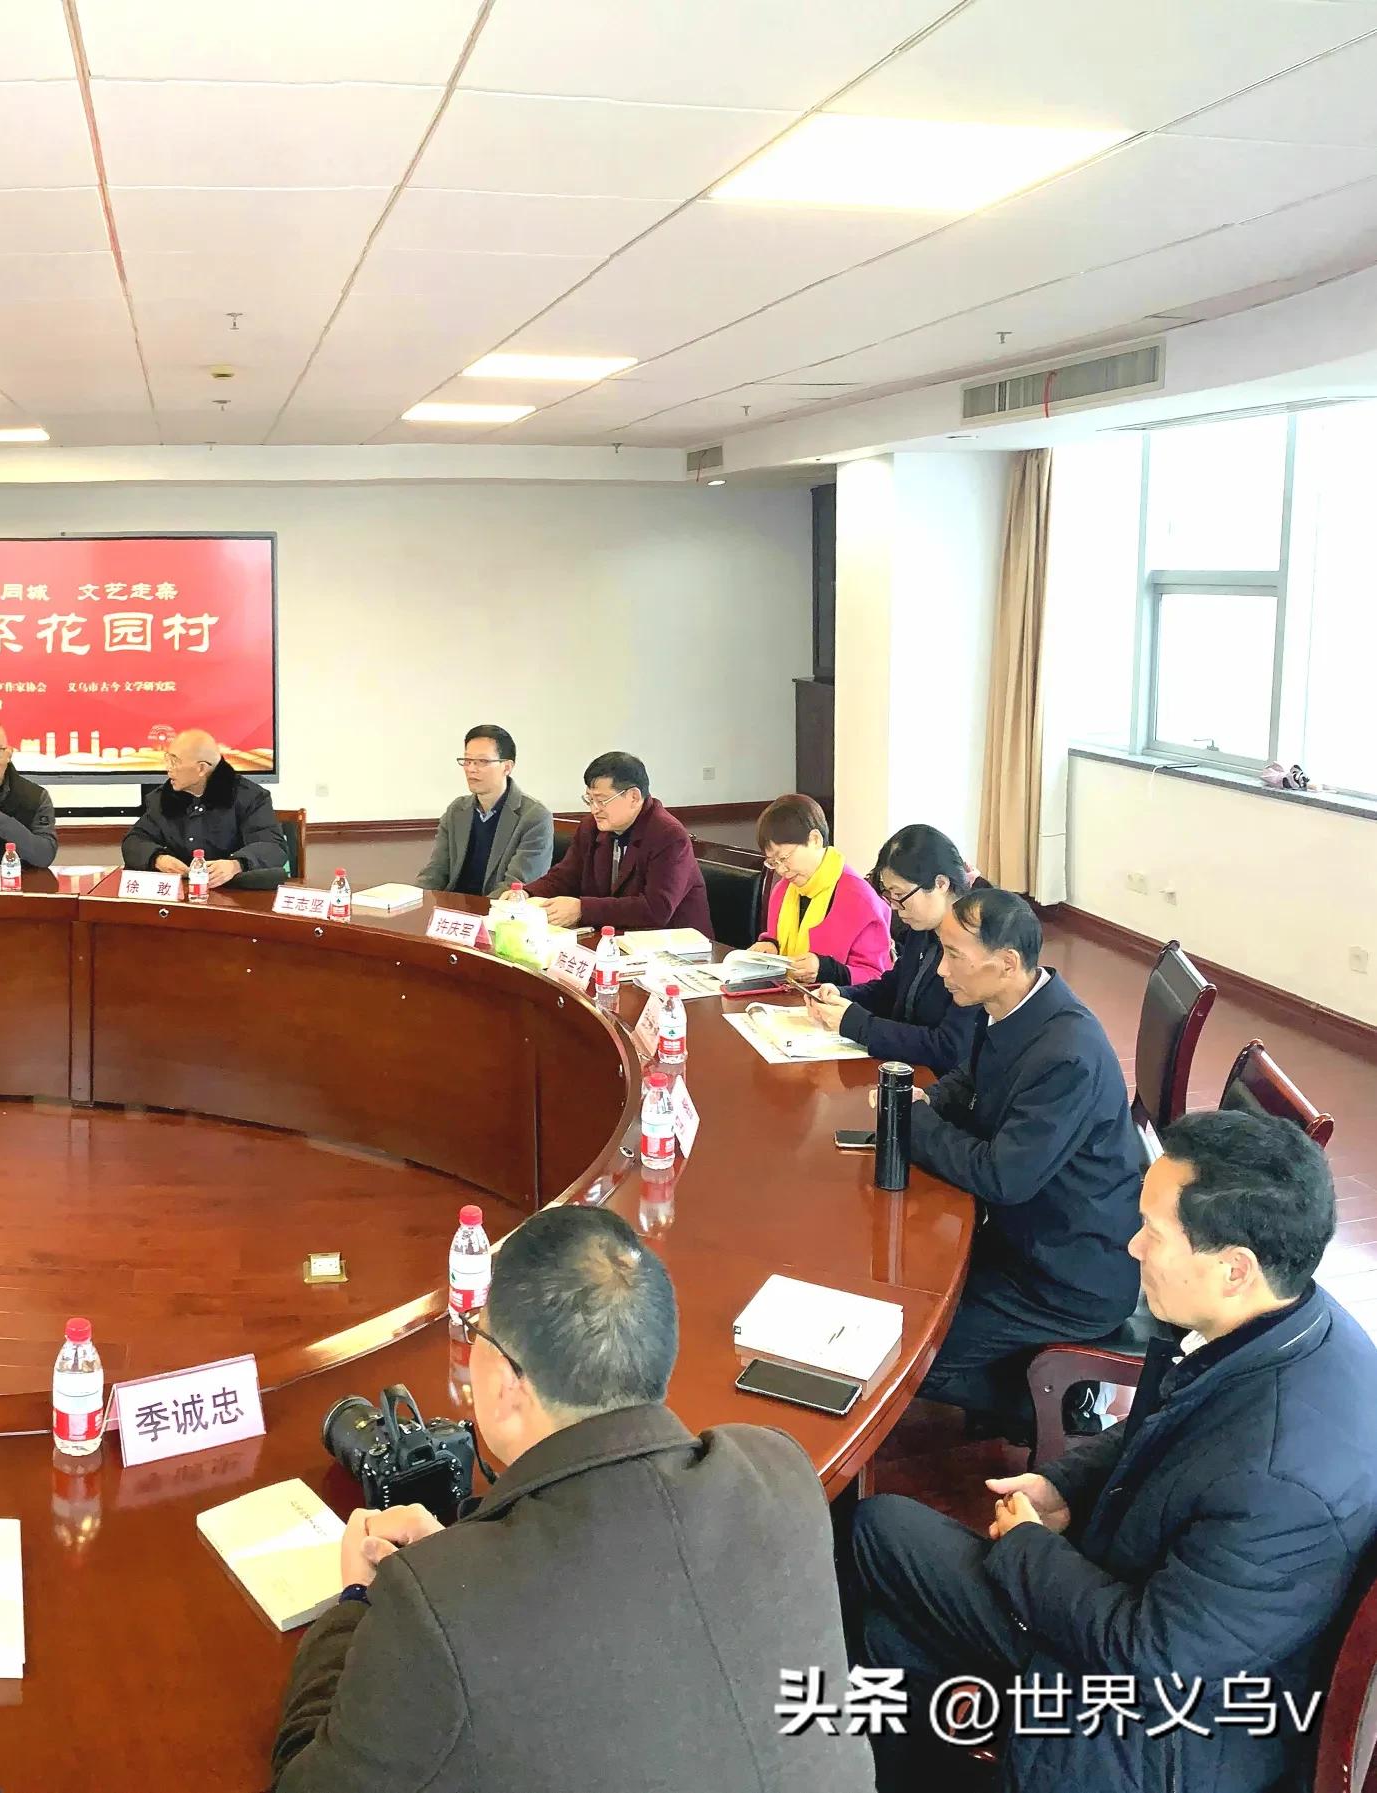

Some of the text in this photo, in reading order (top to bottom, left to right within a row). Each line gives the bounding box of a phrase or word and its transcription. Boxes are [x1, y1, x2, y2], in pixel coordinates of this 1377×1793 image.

[78, 582, 179, 601] 文艺走亲
[281, 895, 323, 914] 王志坚
[437, 917, 475, 938] 许庆军
[135, 1386, 245, 1443] 季诚忠
